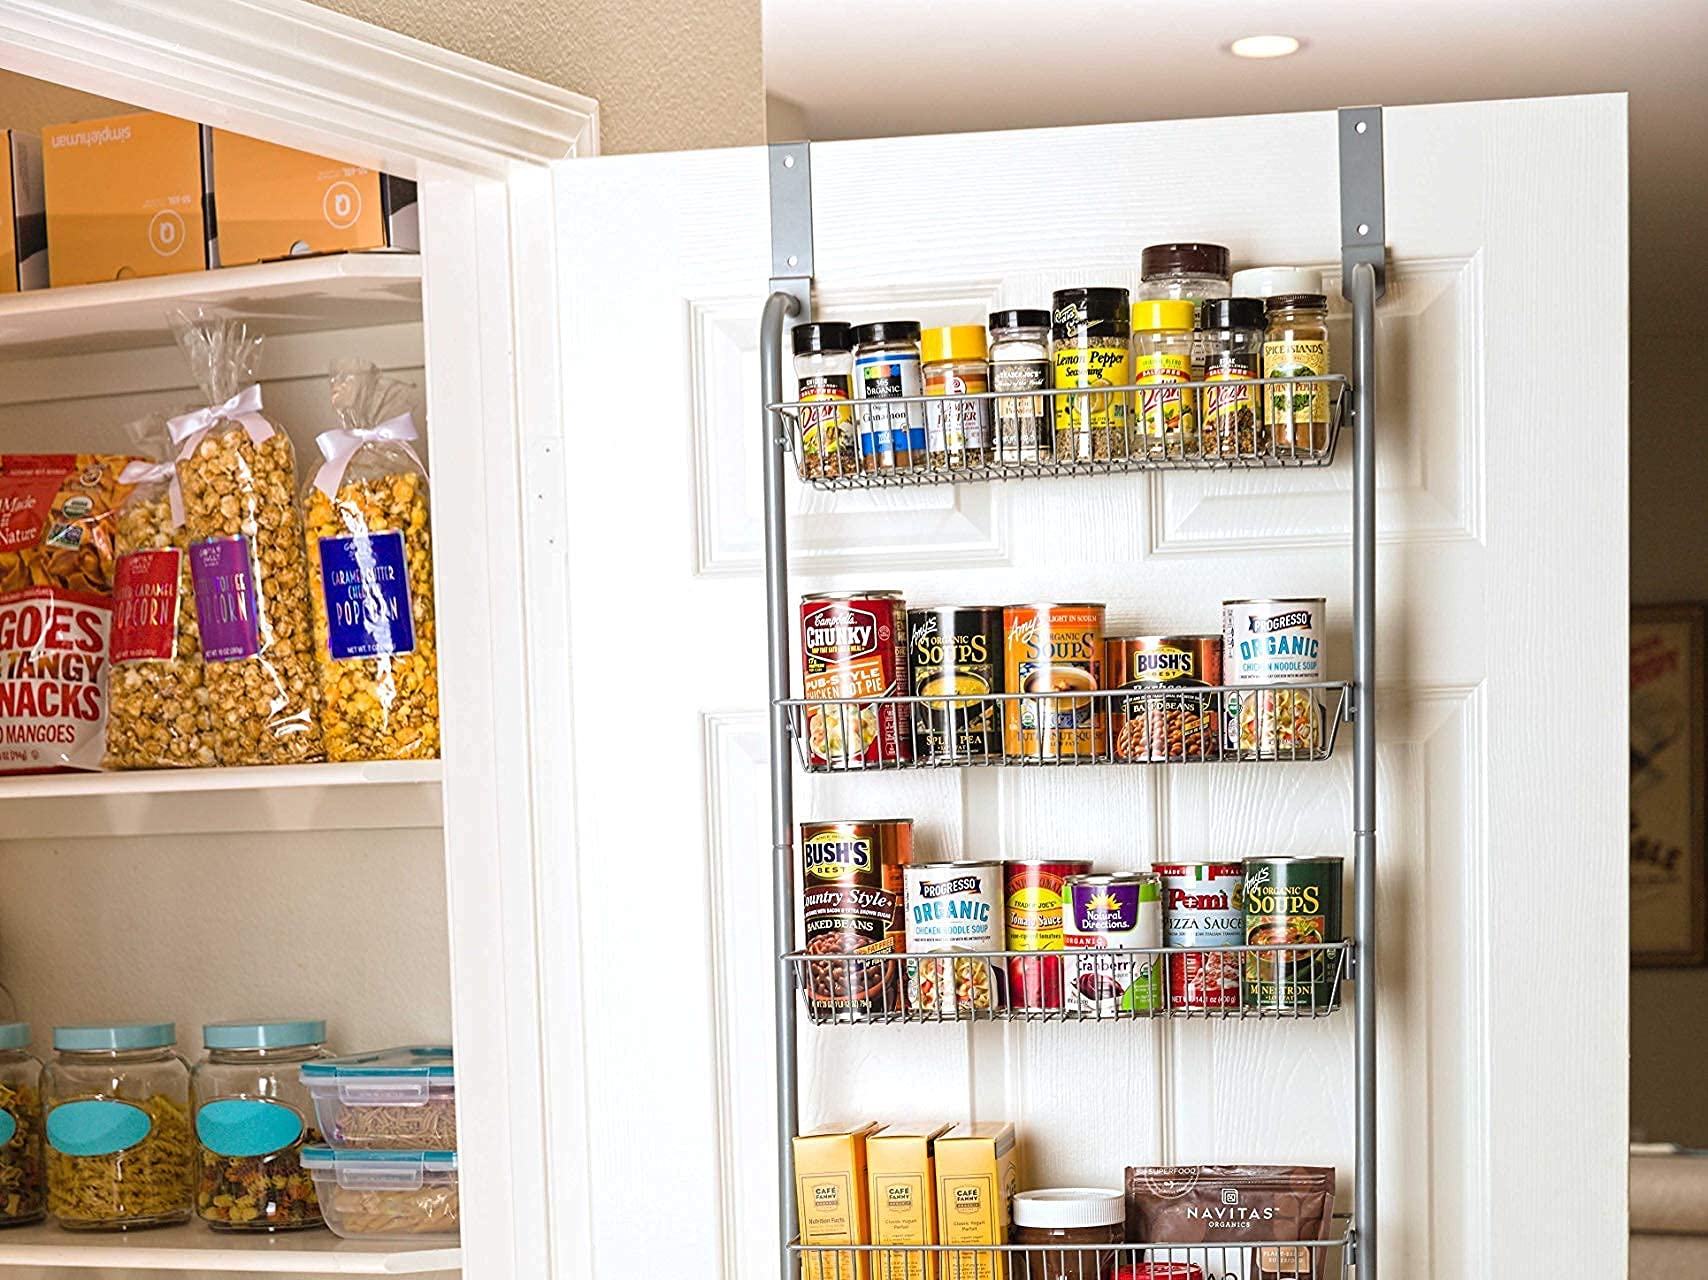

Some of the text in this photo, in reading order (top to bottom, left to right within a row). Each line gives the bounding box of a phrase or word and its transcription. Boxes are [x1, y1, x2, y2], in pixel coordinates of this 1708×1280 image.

[51, 126, 131, 148] simplehuman
[1287, 344, 1323, 354] SLANDS
[1090, 351, 1124, 367] Pepper
[1066, 367, 1103, 379] Seaning
[866, 386, 900, 395] ORGANIC
[331, 568, 362, 586] CARAME
[112, 598, 170, 629] OPCORN
[336, 596, 399, 626] POPN
[815, 612, 857, 627] Campbell's
[1254, 612, 1308, 633] PROGRESSO
[806, 625, 872, 649] CHUNKY
[911, 616, 938, 654] Amy's
[1045, 632, 1080, 641] RGANIC
[917, 634, 987, 665] SOUPS
[1026, 631, 1095, 659] SOUPS
[1240, 635, 1319, 661] ORGANIC
[8, 651, 104, 684] TANGY
[1138, 653, 1191, 673] BUSH'S
[1242, 661, 1317, 672] CHICN NOODLE SOUP
[867, 679, 883, 692] PIE
[1133, 702, 1195, 712] BAED BEANS
[7, 724, 75, 744] MANGOES
[926, 735, 949, 746] SPLI
[805, 841, 868, 868] BUSH'S
[924, 878, 976, 897] PROGRESSO
[1262, 886, 1301, 895] ORGANIC
[847, 889, 887, 909] Style
[1014, 900, 1036, 908] TRADR
[1249, 886, 1319, 914] SOUPS
[913, 900, 990, 925] ORGANIC
[1039, 913, 1062, 926] Sauce
[1086, 911, 1122, 920] Natural
[807, 919, 874, 932] BAKED BEANS
[943, 925, 970, 935] OODLE
[972, 925, 989, 934] SOUP
[1148, 1167, 1196, 1176] SUPERFOOD
[815, 1185, 836, 1194] CAFÉ
[889, 1185, 909, 1195] CAFÉ
[957, 1187, 978, 1196] CAFÉ
[1187, 1207, 1274, 1220] NAVITAS
